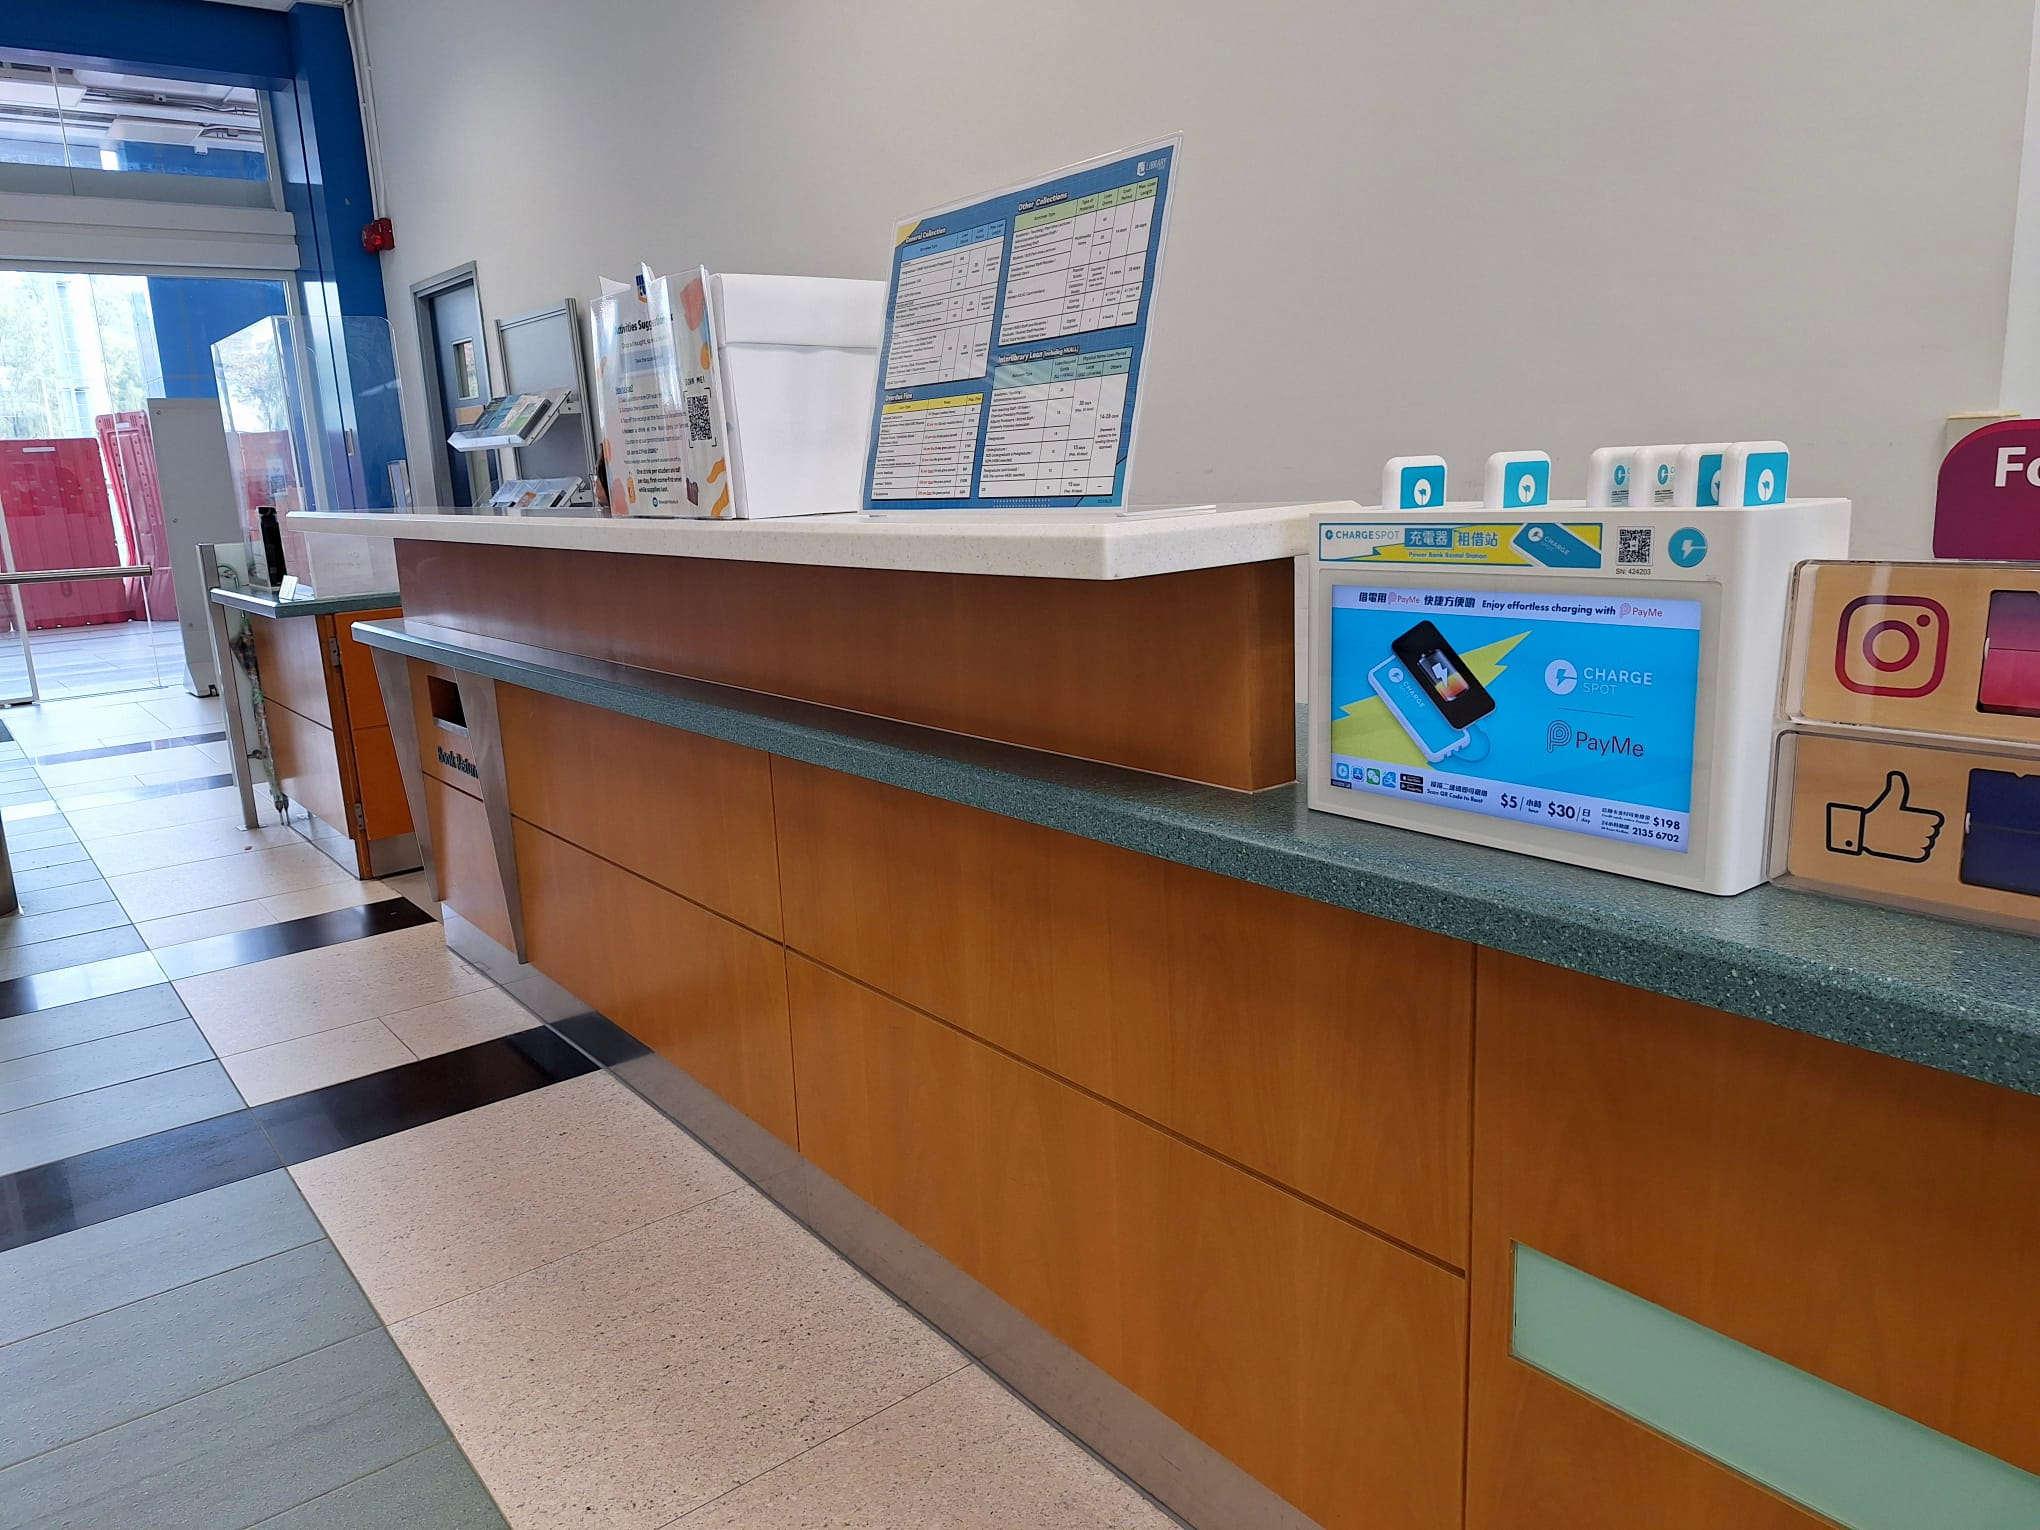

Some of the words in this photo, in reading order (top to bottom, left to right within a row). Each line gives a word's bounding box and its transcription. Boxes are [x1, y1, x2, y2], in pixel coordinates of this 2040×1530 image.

[1018, 200, 1034, 211] Other
[1036, 191, 1068, 206] Collections
[922, 227, 946, 239] Collection
[998, 351, 1029, 363] Interlibrary
[1029, 350, 1043, 359] Loan
[1409, 530, 1448, 546] 充電器
[1457, 532, 1498, 547] 租借站
[1544, 535, 1571, 556] CHARGE
[1408, 551, 1427, 559] Power
[1628, 568, 1651, 576] 424203
[1359, 591, 1387, 604] 借電用
[1397, 595, 1420, 605] PayMe
[1481, 600, 1505, 611] Enjoy
[1507, 601, 1549, 612] effortless
[1551, 601, 1592, 616] charging
[1594, 605, 1616, 616] with
[1632, 607, 1663, 618] PayMe
[1583, 667, 1653, 686] CHARGE
[1403, 681, 1425, 709] CHARGE
[1583, 683, 1617, 695] SPOT
[1576, 731, 1645, 757] PayMe
[1427, 788, 1439, 796] Scan
[1449, 792, 1463, 800] Code
[1500, 792, 1518, 809] $5
[1548, 800, 1576, 820] $30
[1653, 816, 1680, 830] $198
[1632, 826, 1654, 838] 2135
[1655, 831, 1679, 843] 6702
